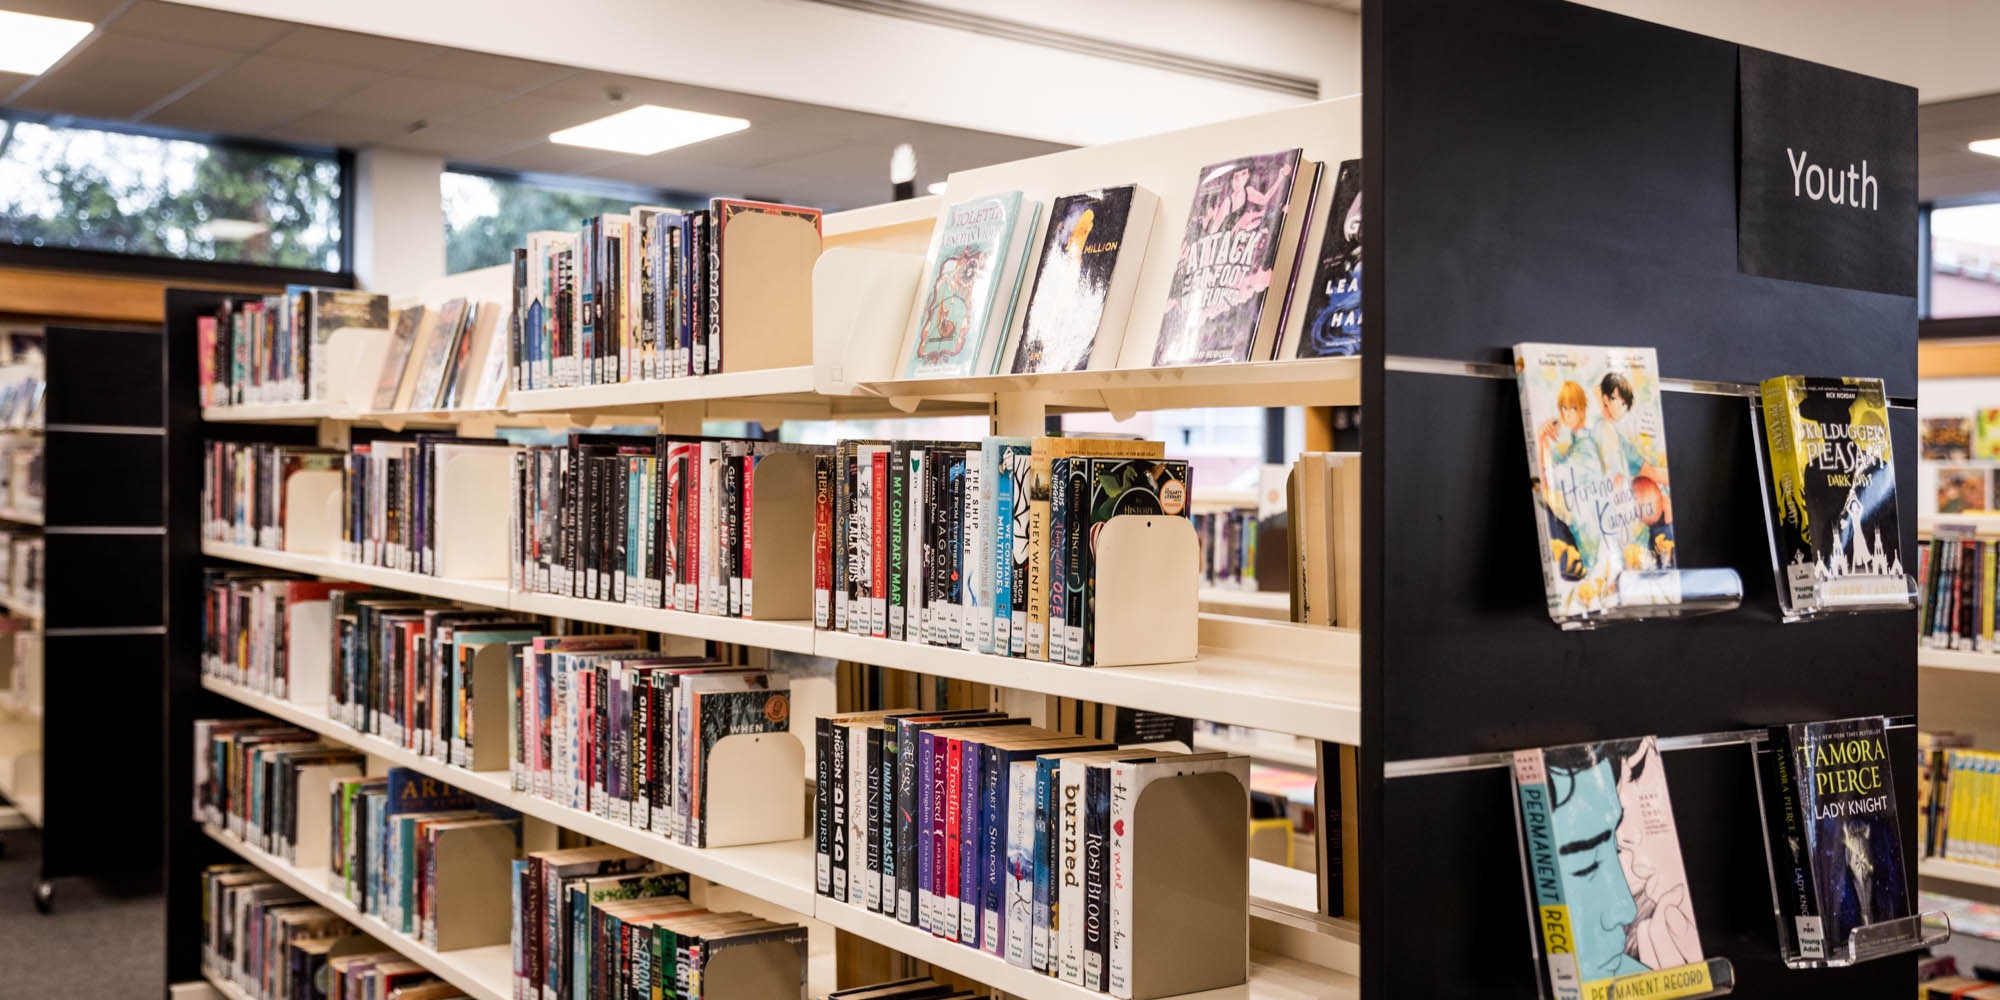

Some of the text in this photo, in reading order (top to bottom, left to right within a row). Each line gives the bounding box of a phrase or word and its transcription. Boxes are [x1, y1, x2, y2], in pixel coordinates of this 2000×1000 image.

[1787, 148, 1878, 211] Youth
[1084, 241, 1118, 254] MILLION
[1187, 231, 1262, 274] ATTACK
[1800, 423, 1887, 440] SKULDUGGERY
[837, 446, 845, 480] REBEL
[1806, 441, 1888, 474] PLEASANT
[1828, 474, 1851, 488] DARK
[728, 466, 736, 513] GHOST
[818, 470, 828, 504] HERO
[817, 523, 827, 554] FALL
[971, 499, 979, 529] SHIP
[849, 513, 858, 583] BLACK KIDS
[891, 476, 902, 607] MY CONTRARY MARY
[938, 510, 947, 600] MAGONIA
[995, 516, 1004, 595] MULTITUDES
[1004, 523, 1012, 588] WE CONTAIN
[1031, 511, 1040, 624] THEY WENT LEF
[730, 724, 763, 734] WHEN
[1797, 737, 1886, 769] TAMORA
[638, 736, 646, 785] MANS
[901, 742, 914, 797] Elegy
[1815, 765, 1882, 796] PIERCE
[820, 761, 828, 852] GREAT PURSU
[922, 783, 931, 824] Kingdom
[934, 754, 946, 822] Ice Kissed
[948, 759, 959, 825] Frostfire
[1112, 782, 1127, 816] this
[1814, 795, 1887, 820] LADY KNIGHT
[834, 787, 844, 862] DEAD
[867, 767, 879, 871] SPINDLE FIR
[883, 762, 894, 876] UNNATURAL DISASTE
[988, 769, 998, 885] HEART SHADOW
[1065, 784, 1081, 888] burned
[1524, 788, 1559, 902] PERMANENT
[1087, 833, 1102, 943] ROSEBLOOD
[1795, 867, 1806, 892] LADY
[631, 928, 641, 990] MICHAEL GRANT
[676, 947, 690, 998] LIGHT
[1803, 945, 1821, 953] Adult
[639, 951, 650, 1000] FRONT
[1591, 970, 1704, 1000] PEMANENT RECORD
